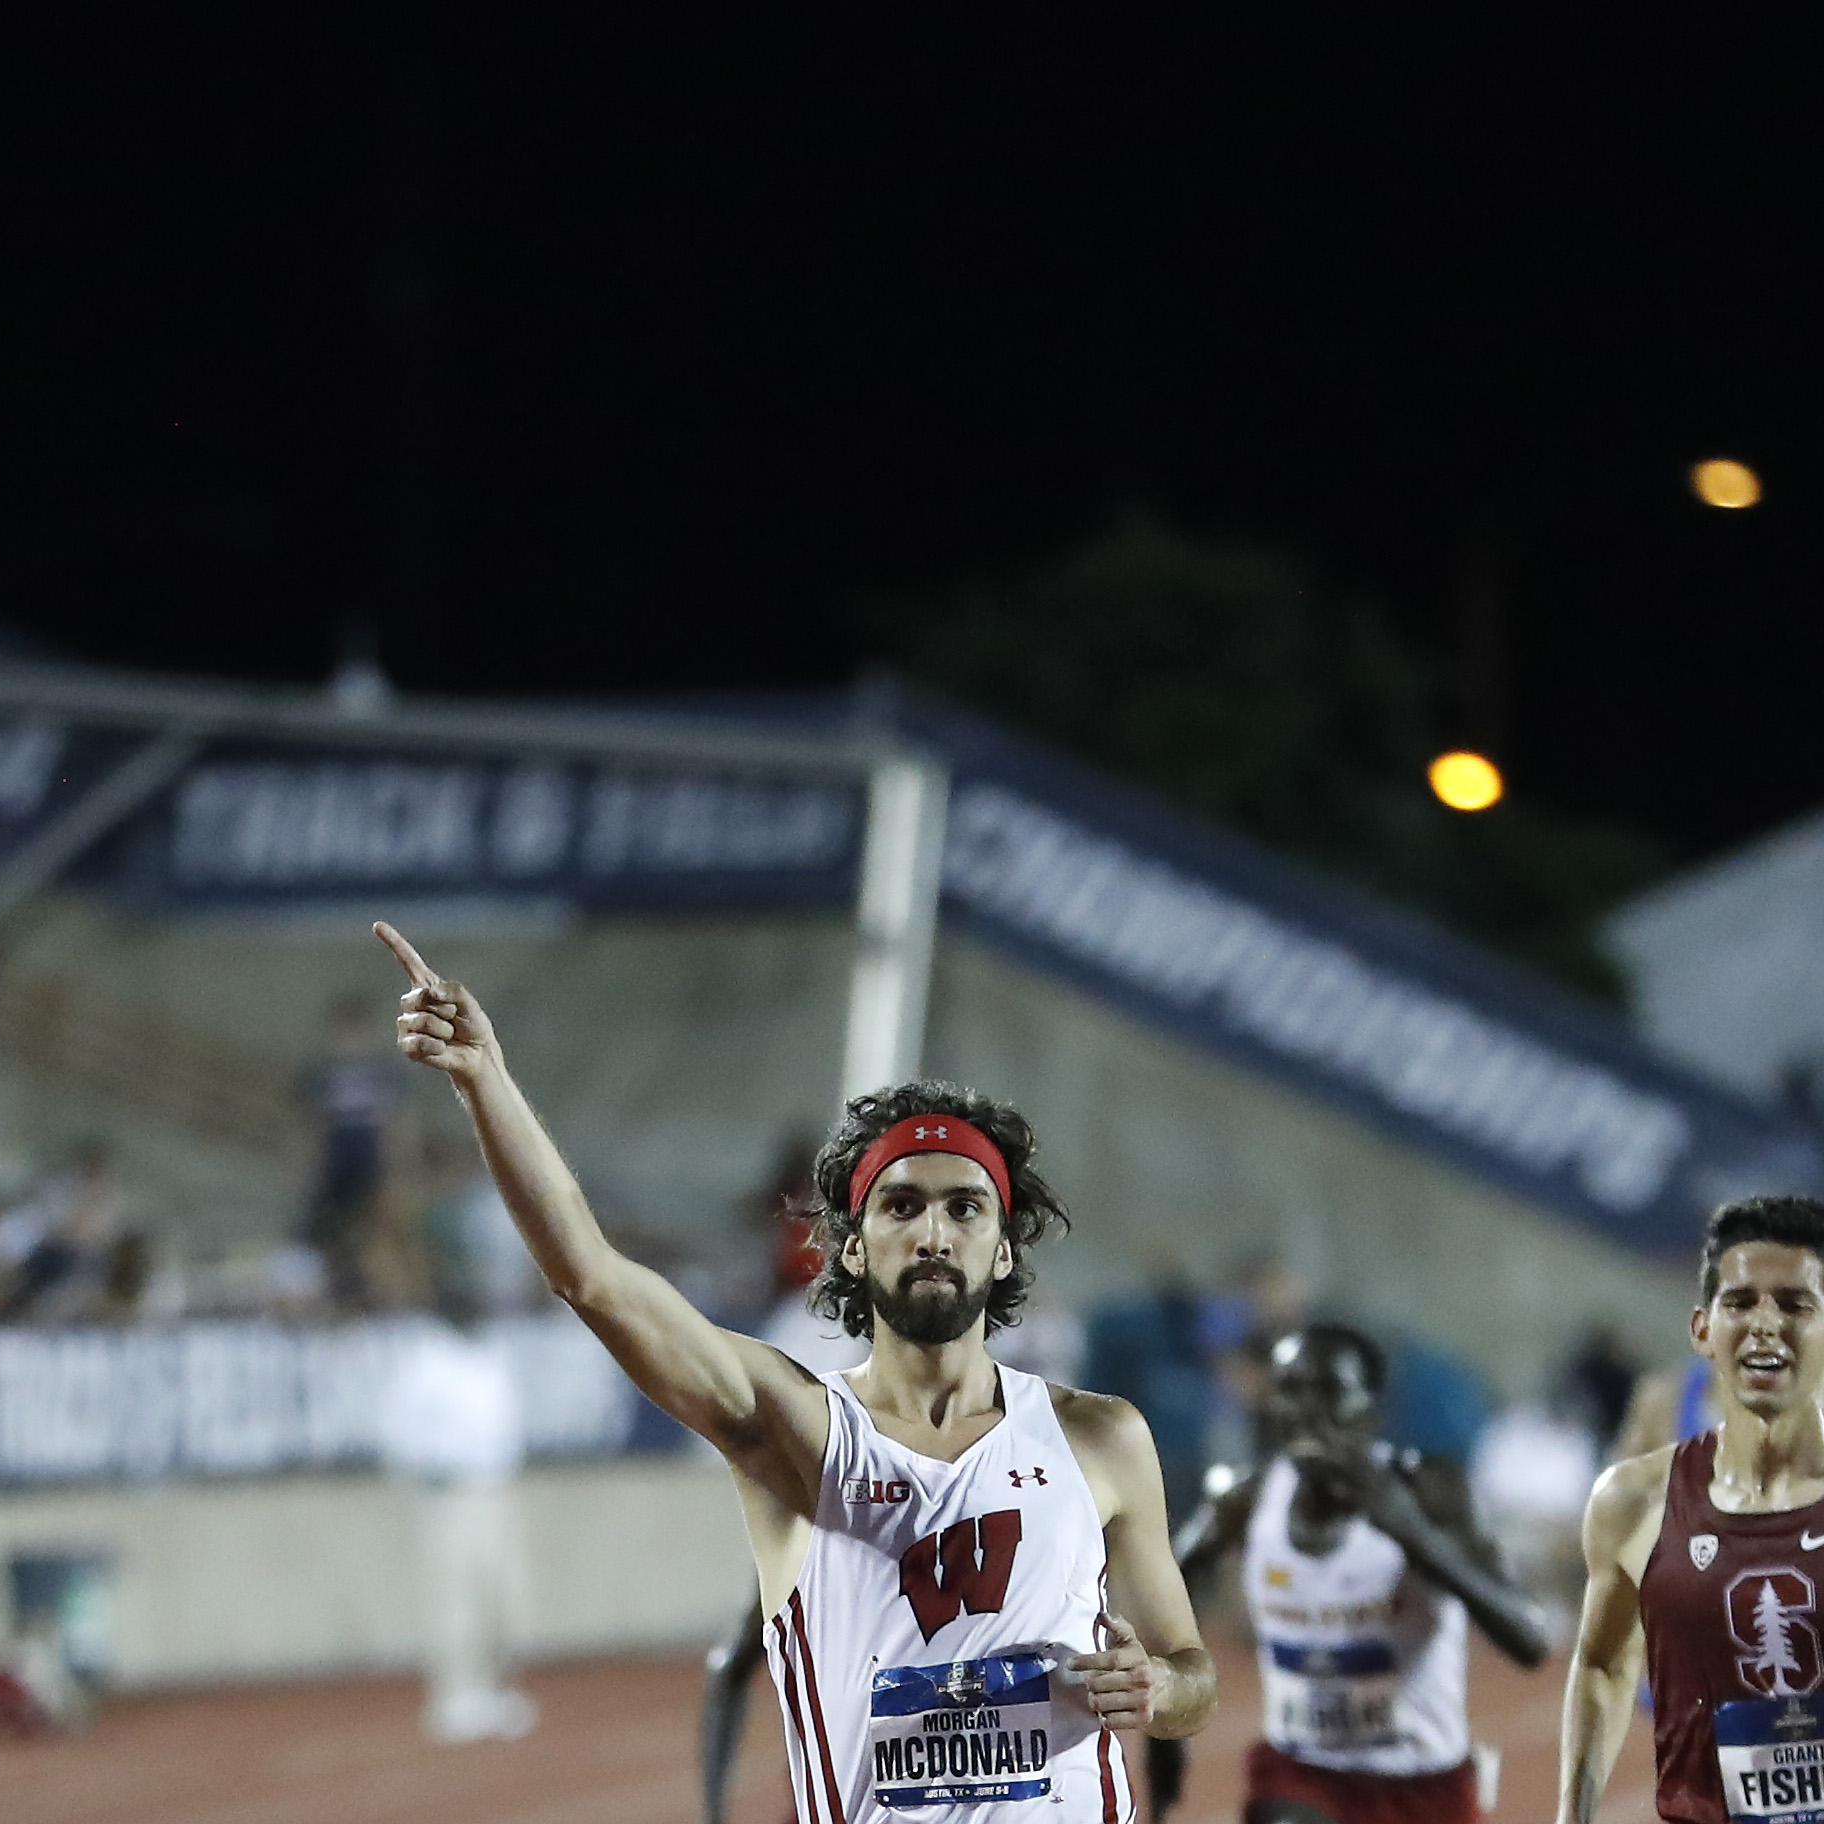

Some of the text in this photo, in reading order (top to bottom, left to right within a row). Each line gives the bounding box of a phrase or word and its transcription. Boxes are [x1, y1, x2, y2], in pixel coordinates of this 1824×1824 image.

[899, 1508, 1023, 1647] W
[922, 1709, 1001, 1733] MORGAN
[874, 1728, 1049, 1783] MCDONALD
